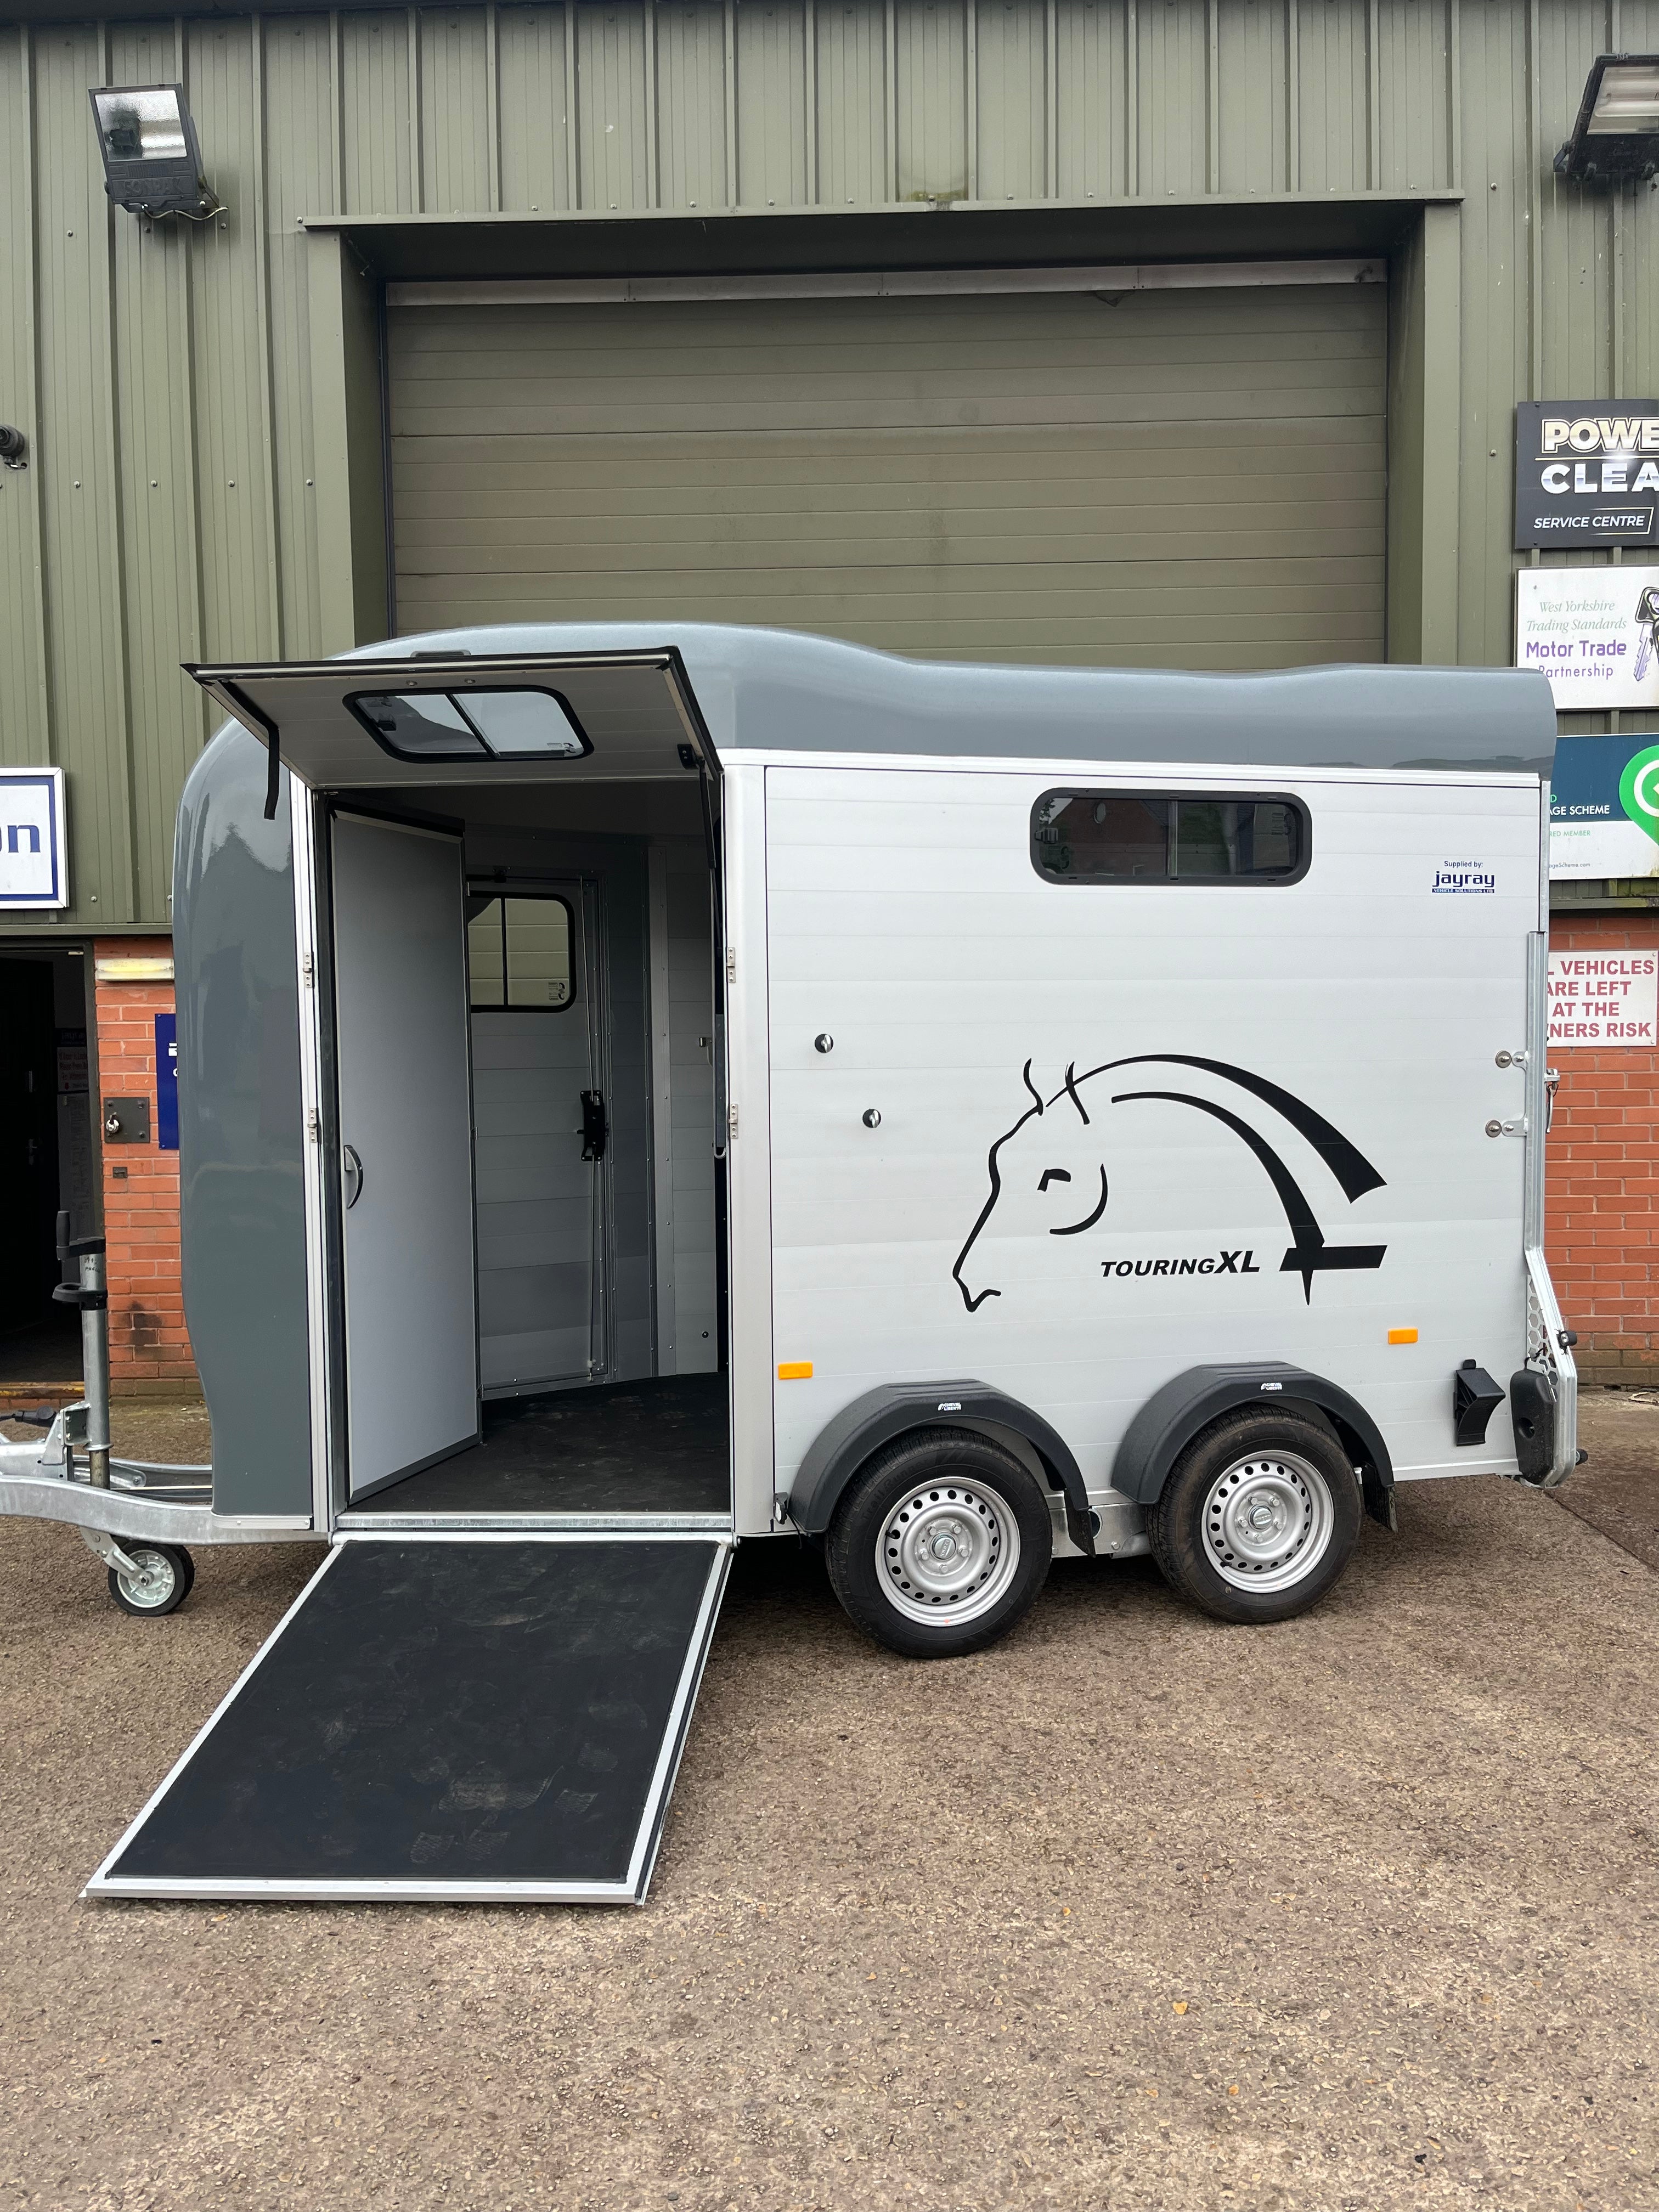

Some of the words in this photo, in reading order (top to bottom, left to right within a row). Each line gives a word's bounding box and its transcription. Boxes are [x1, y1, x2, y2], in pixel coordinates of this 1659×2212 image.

[1541, 417, 1659, 453] POWE
[1541, 462, 1659, 494] CLEA
[1533, 517, 1590, 529] SERVICE
[1592, 515, 1645, 527] CENTRE
[1539, 601, 1562, 612] West
[1565, 600, 1615, 612] Yorkshire
[1527, 620, 1569, 633] Trading
[1571, 617, 1627, 630] Standards
[1526, 641, 1574, 658] Motor
[1579, 639, 1627, 657] Trade
[1570, 805, 1610, 815] SCHEME
[1432, 871, 1495, 888] jayray
[1560, 960, 1654, 975] VEHICLES
[1585, 981, 1632, 996] LEFT
[1552, 1002, 1576, 1017] AT
[1582, 1002, 1620, 1017] THE
[1547, 1023, 1600, 1037] NERS
[1606, 1023, 1651, 1037] RISK
[1100, 1250, 1261, 1278] TOURINGXL
